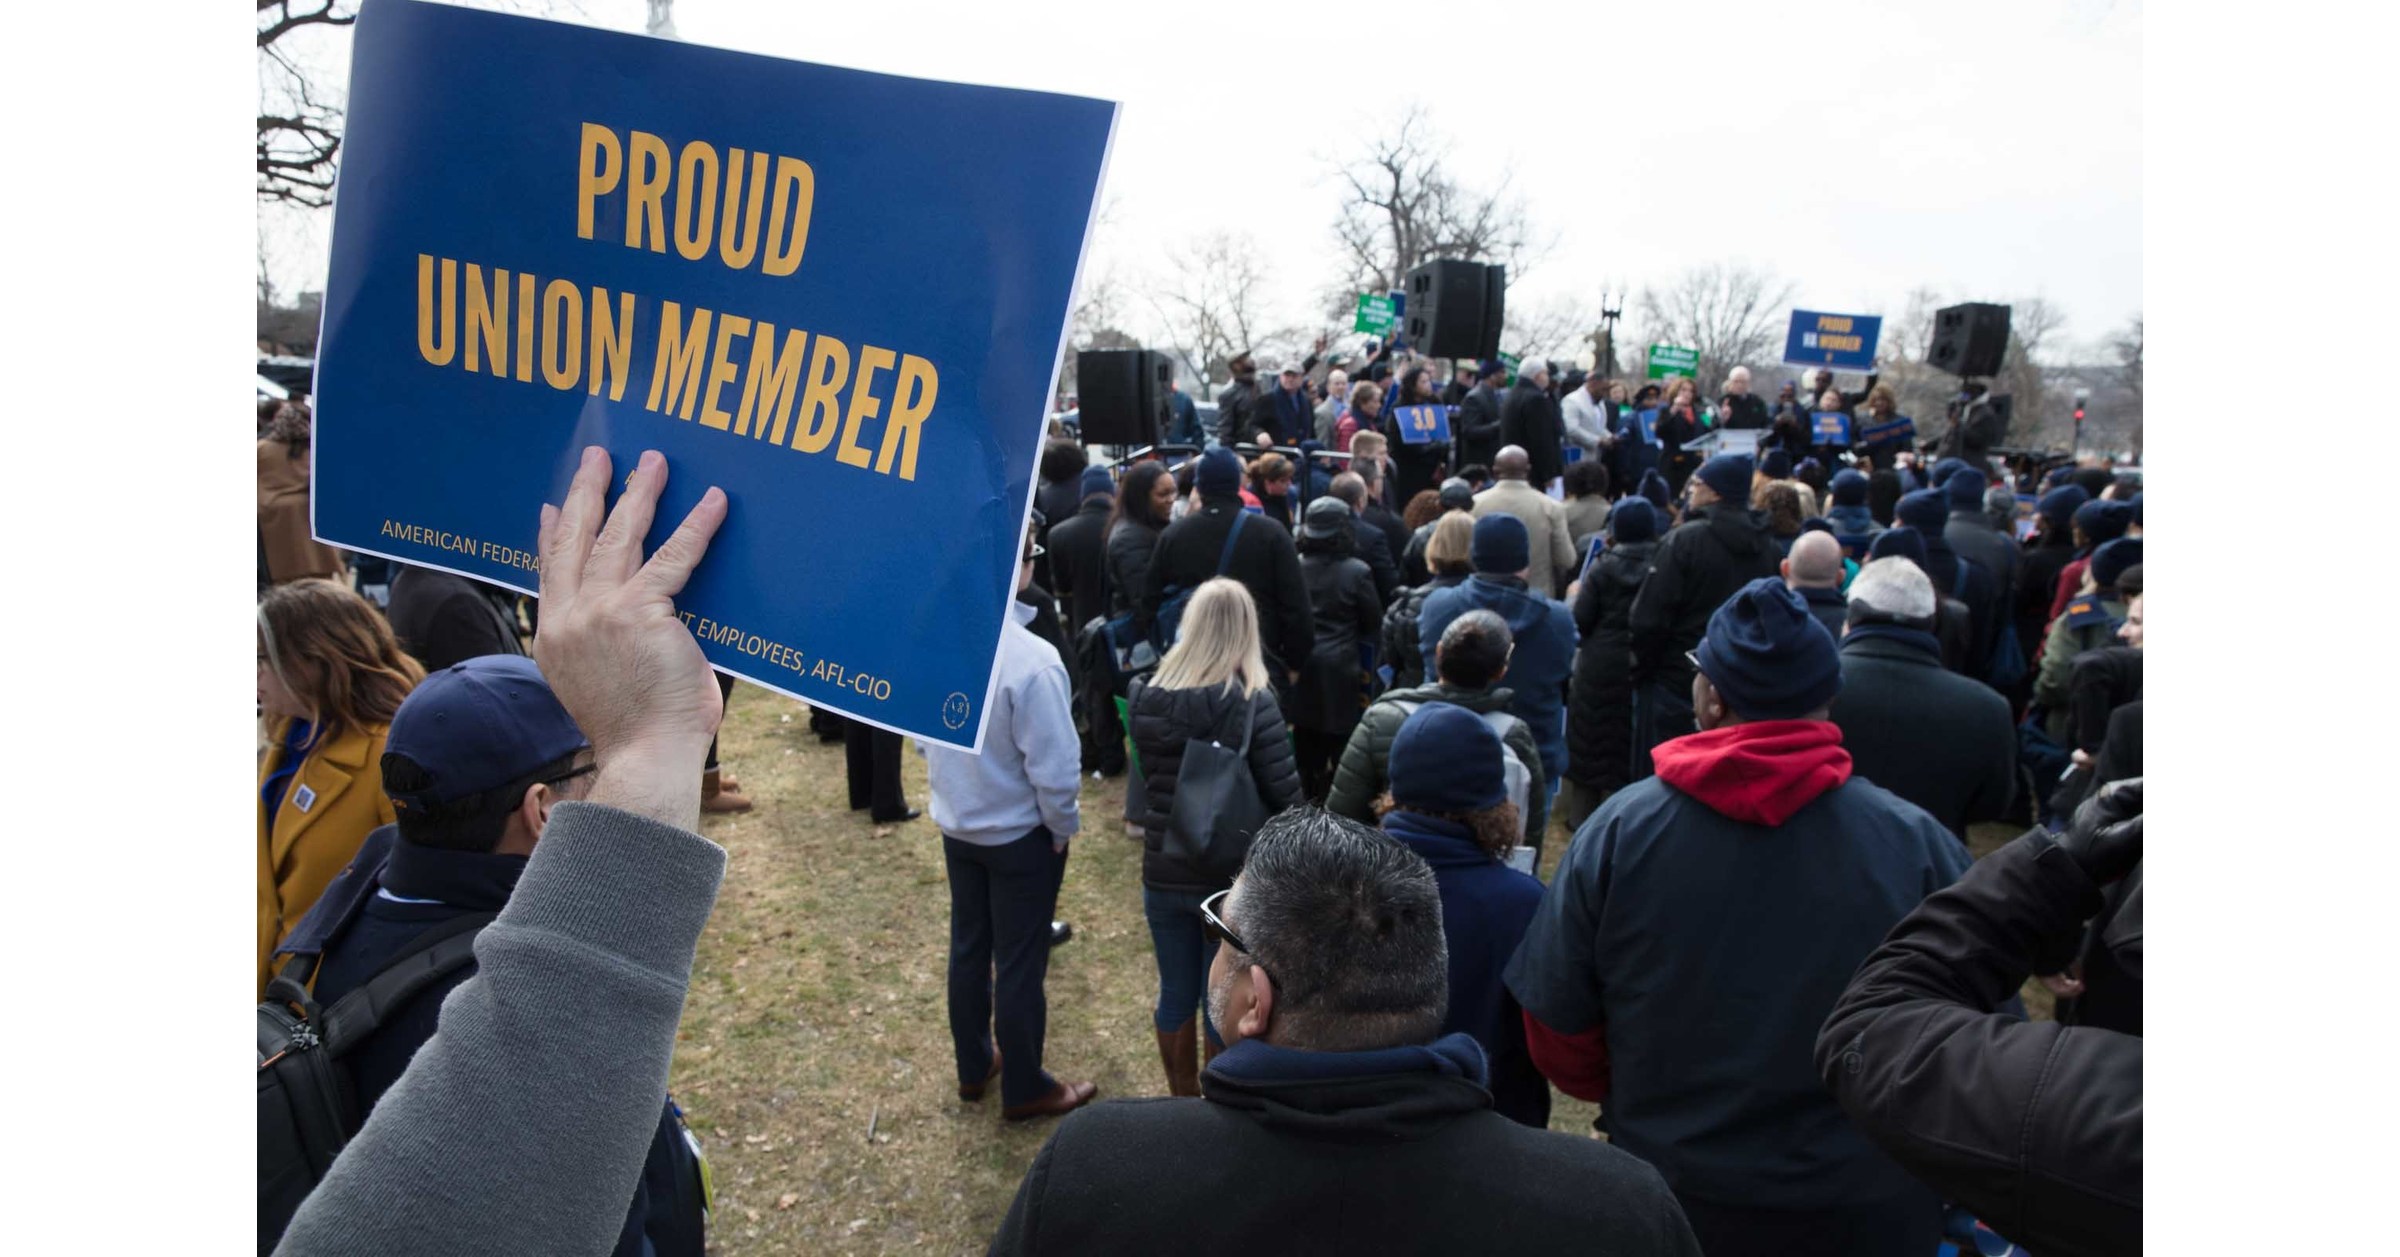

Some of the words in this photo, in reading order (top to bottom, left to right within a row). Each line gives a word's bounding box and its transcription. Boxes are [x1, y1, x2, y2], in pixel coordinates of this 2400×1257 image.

[577, 122, 815, 277] PROUD
[417, 253, 636, 403] UNION
[646, 300, 939, 482] MEMBER
[1410, 406, 1437, 431] 3.0
[380, 519, 477, 556] AMERICAN
[696, 617, 807, 677] EMPLOYEES,
[810, 658, 892, 701] AFL-CIO
